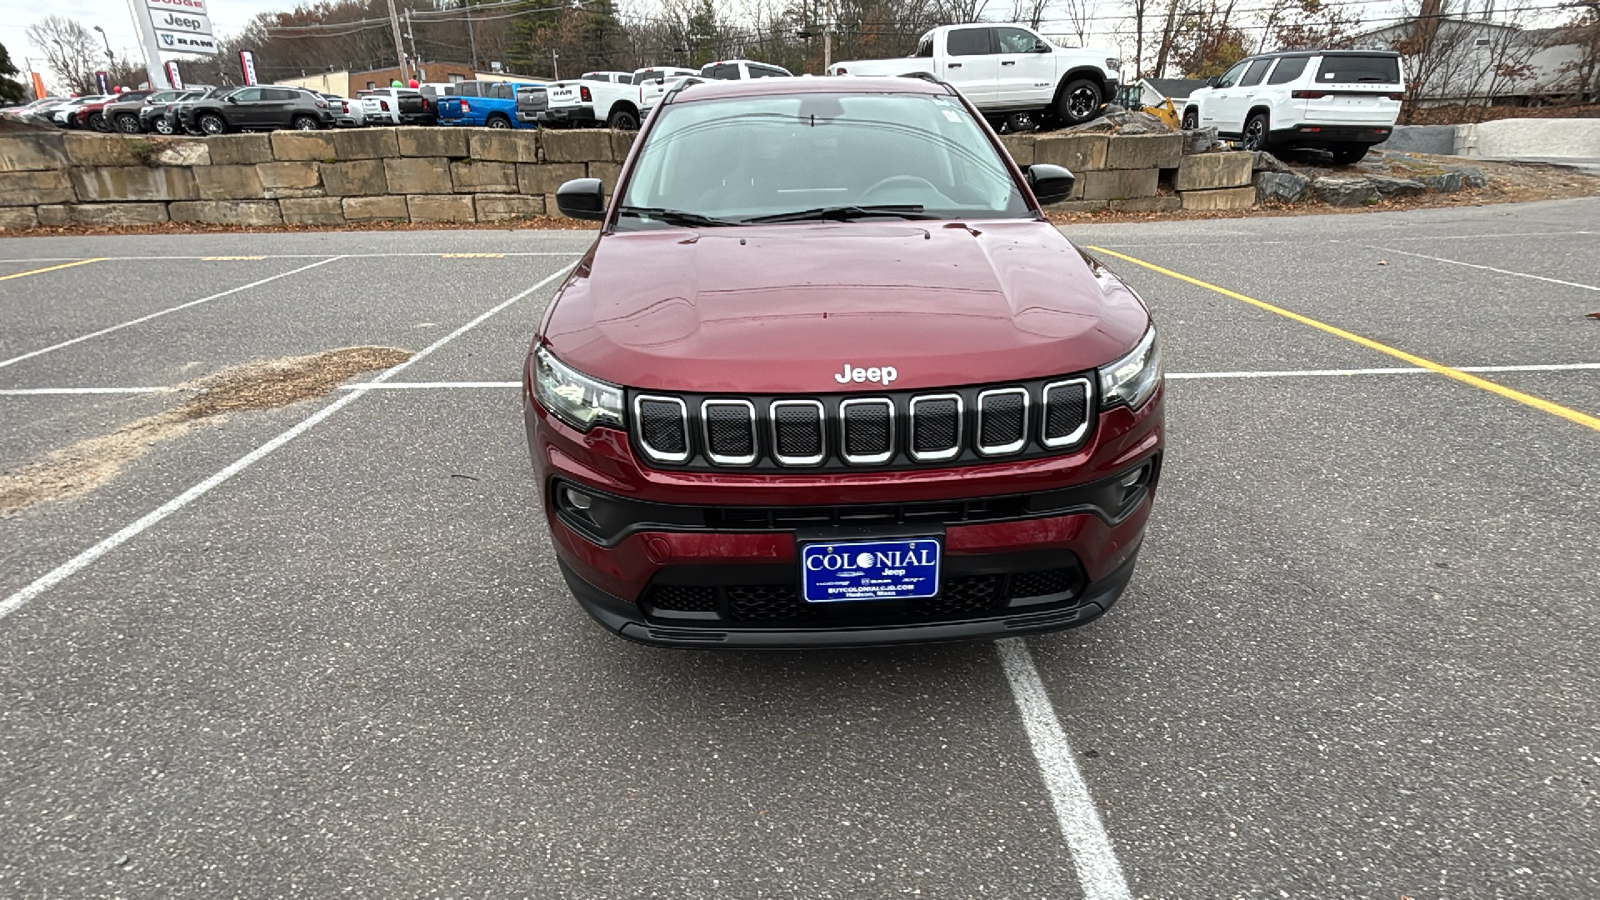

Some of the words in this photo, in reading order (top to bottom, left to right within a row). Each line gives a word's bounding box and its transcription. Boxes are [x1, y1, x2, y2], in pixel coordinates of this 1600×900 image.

[150, 0, 203, 8] ODGE
[164, 13, 201, 30] Jeep
[177, 37, 214, 48] RAM
[834, 363, 898, 386] Jeep
[806, 549, 936, 571] COLONIAL
[881, 567, 906, 577] Jeep
